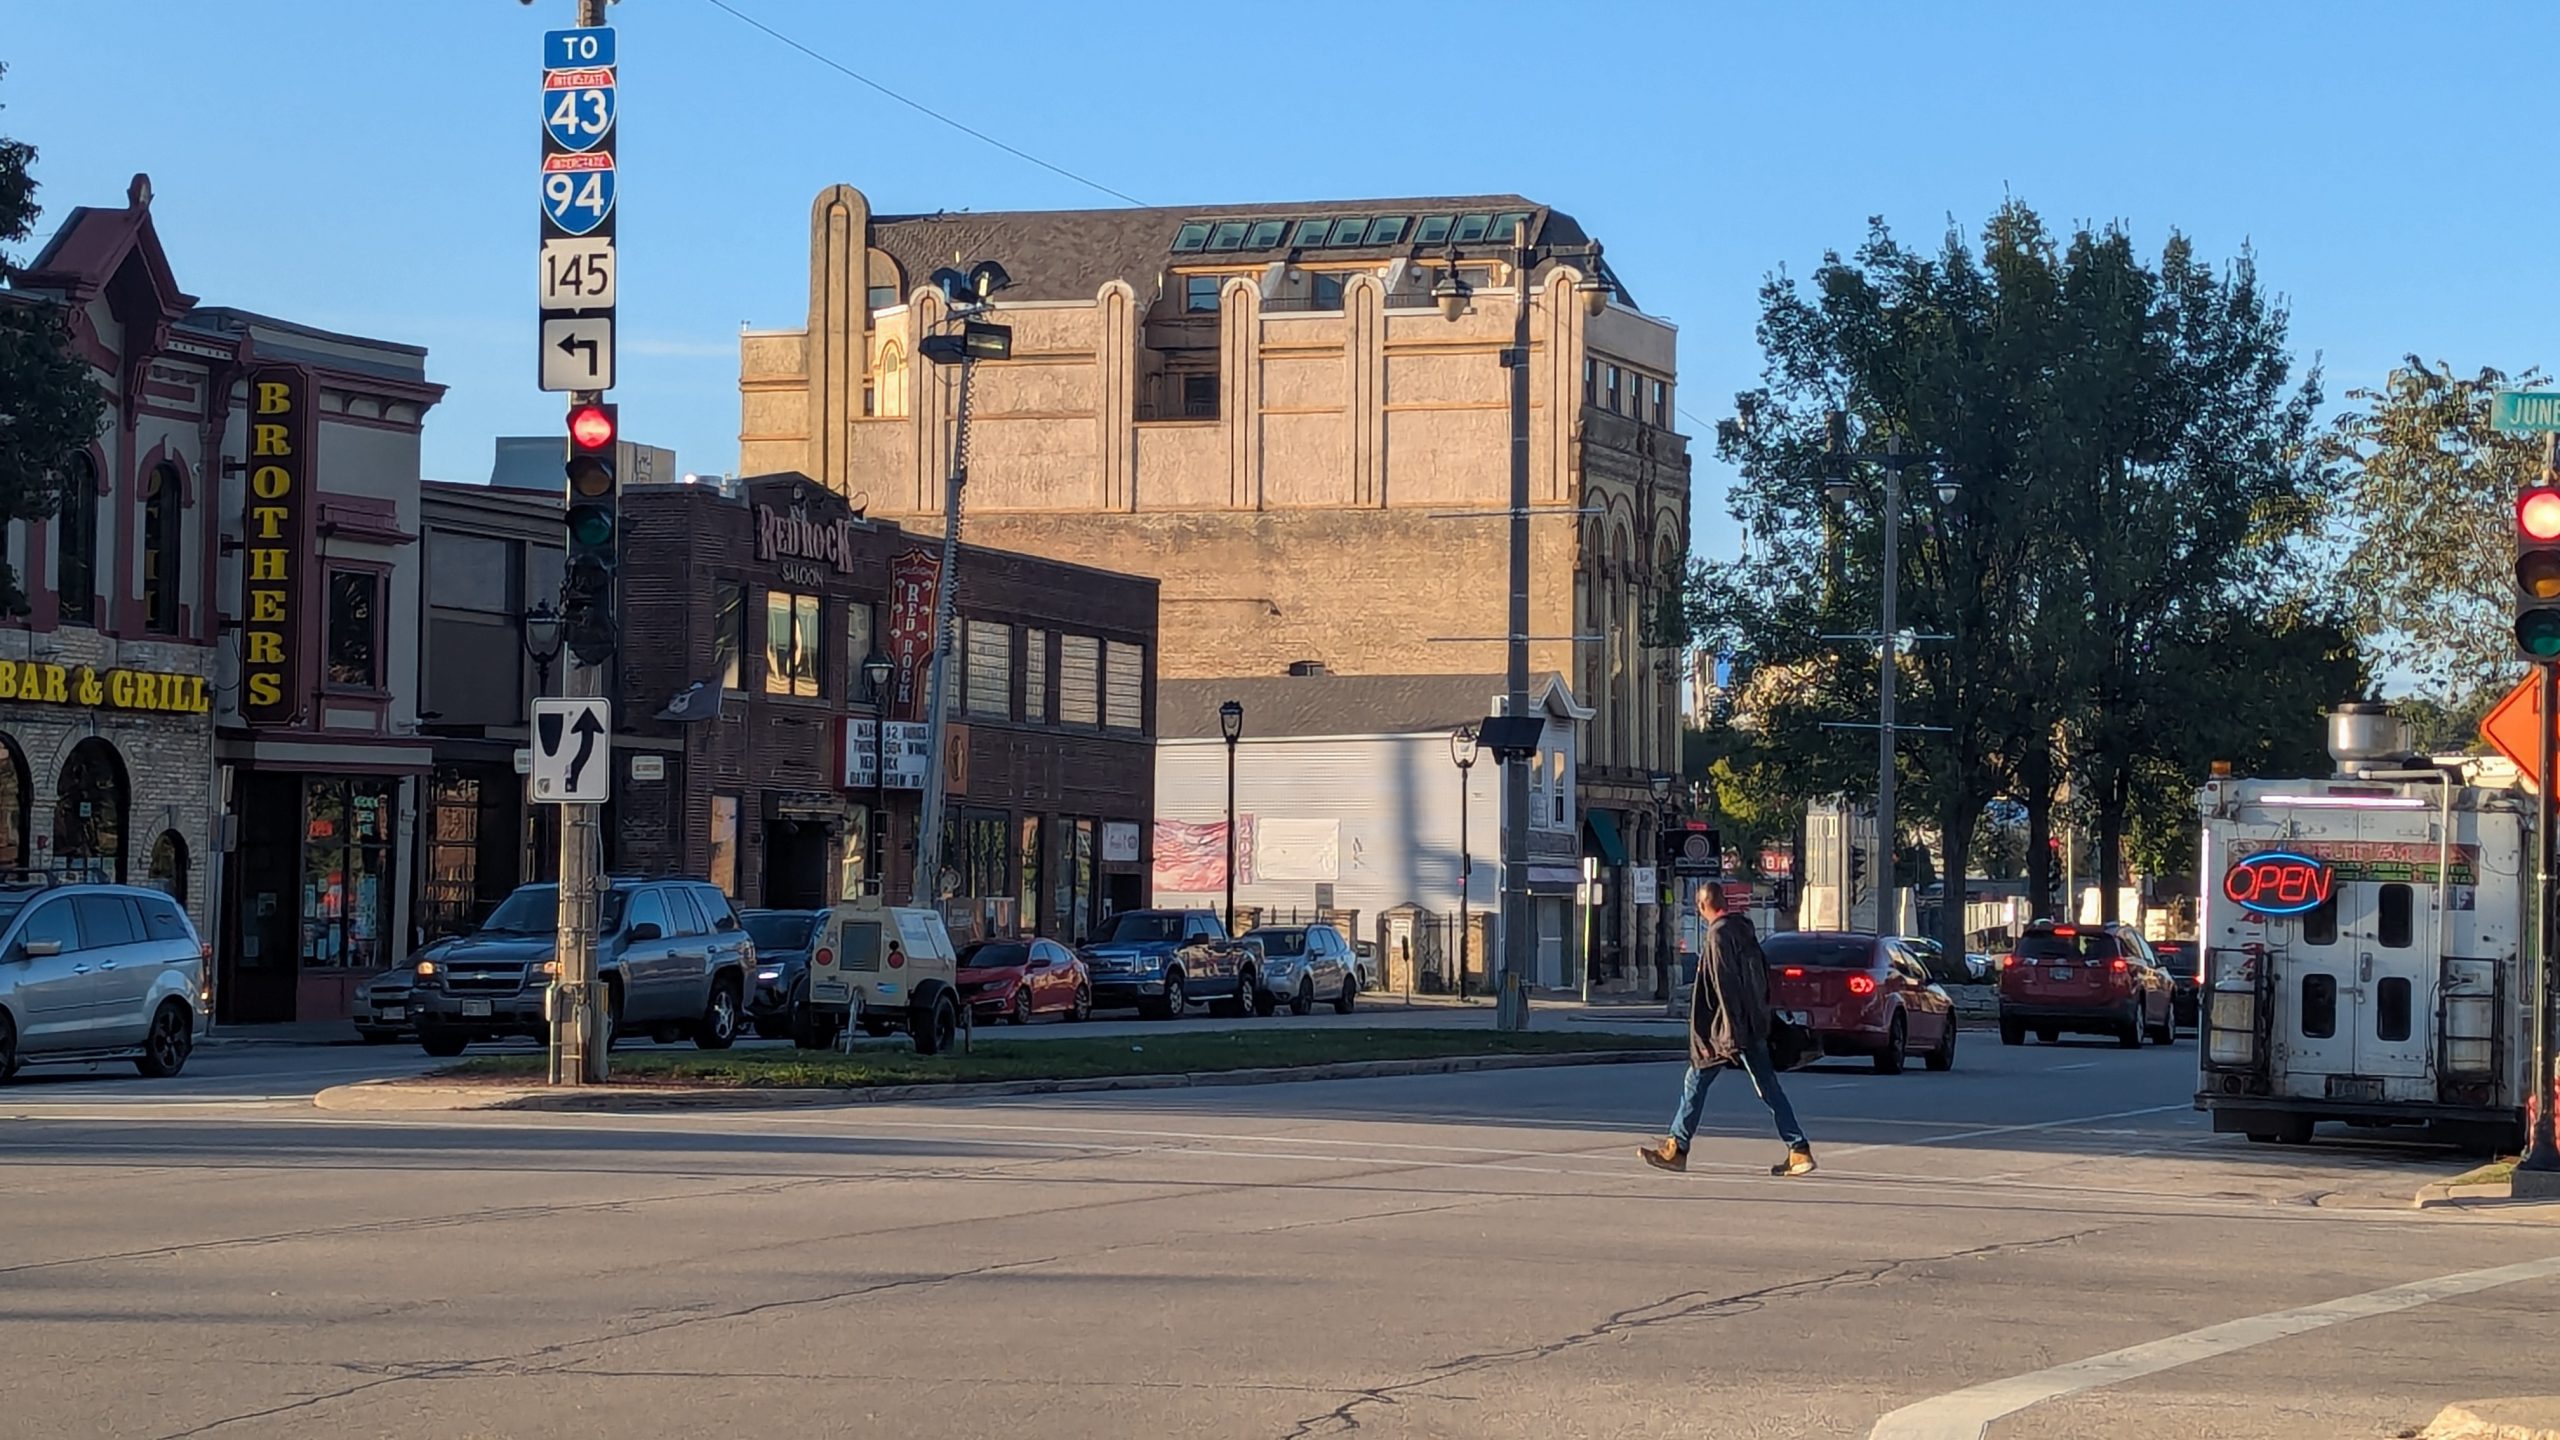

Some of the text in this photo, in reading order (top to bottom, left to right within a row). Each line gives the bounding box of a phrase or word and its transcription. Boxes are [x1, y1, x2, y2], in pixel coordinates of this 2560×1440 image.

[562, 36, 598, 60] TO
[553, 73, 605, 87] INTERSTATE
[549, 89, 608, 135] 43
[545, 173, 604, 217] 94
[547, 252, 609, 297] 145
[247, 382, 292, 706] BROTHERS
[905, 583, 920, 632] RED
[0, 660, 209, 713] BAR & GRILL
[898, 639, 914, 704] ROCK
[2226, 864, 2332, 902] OPEN
